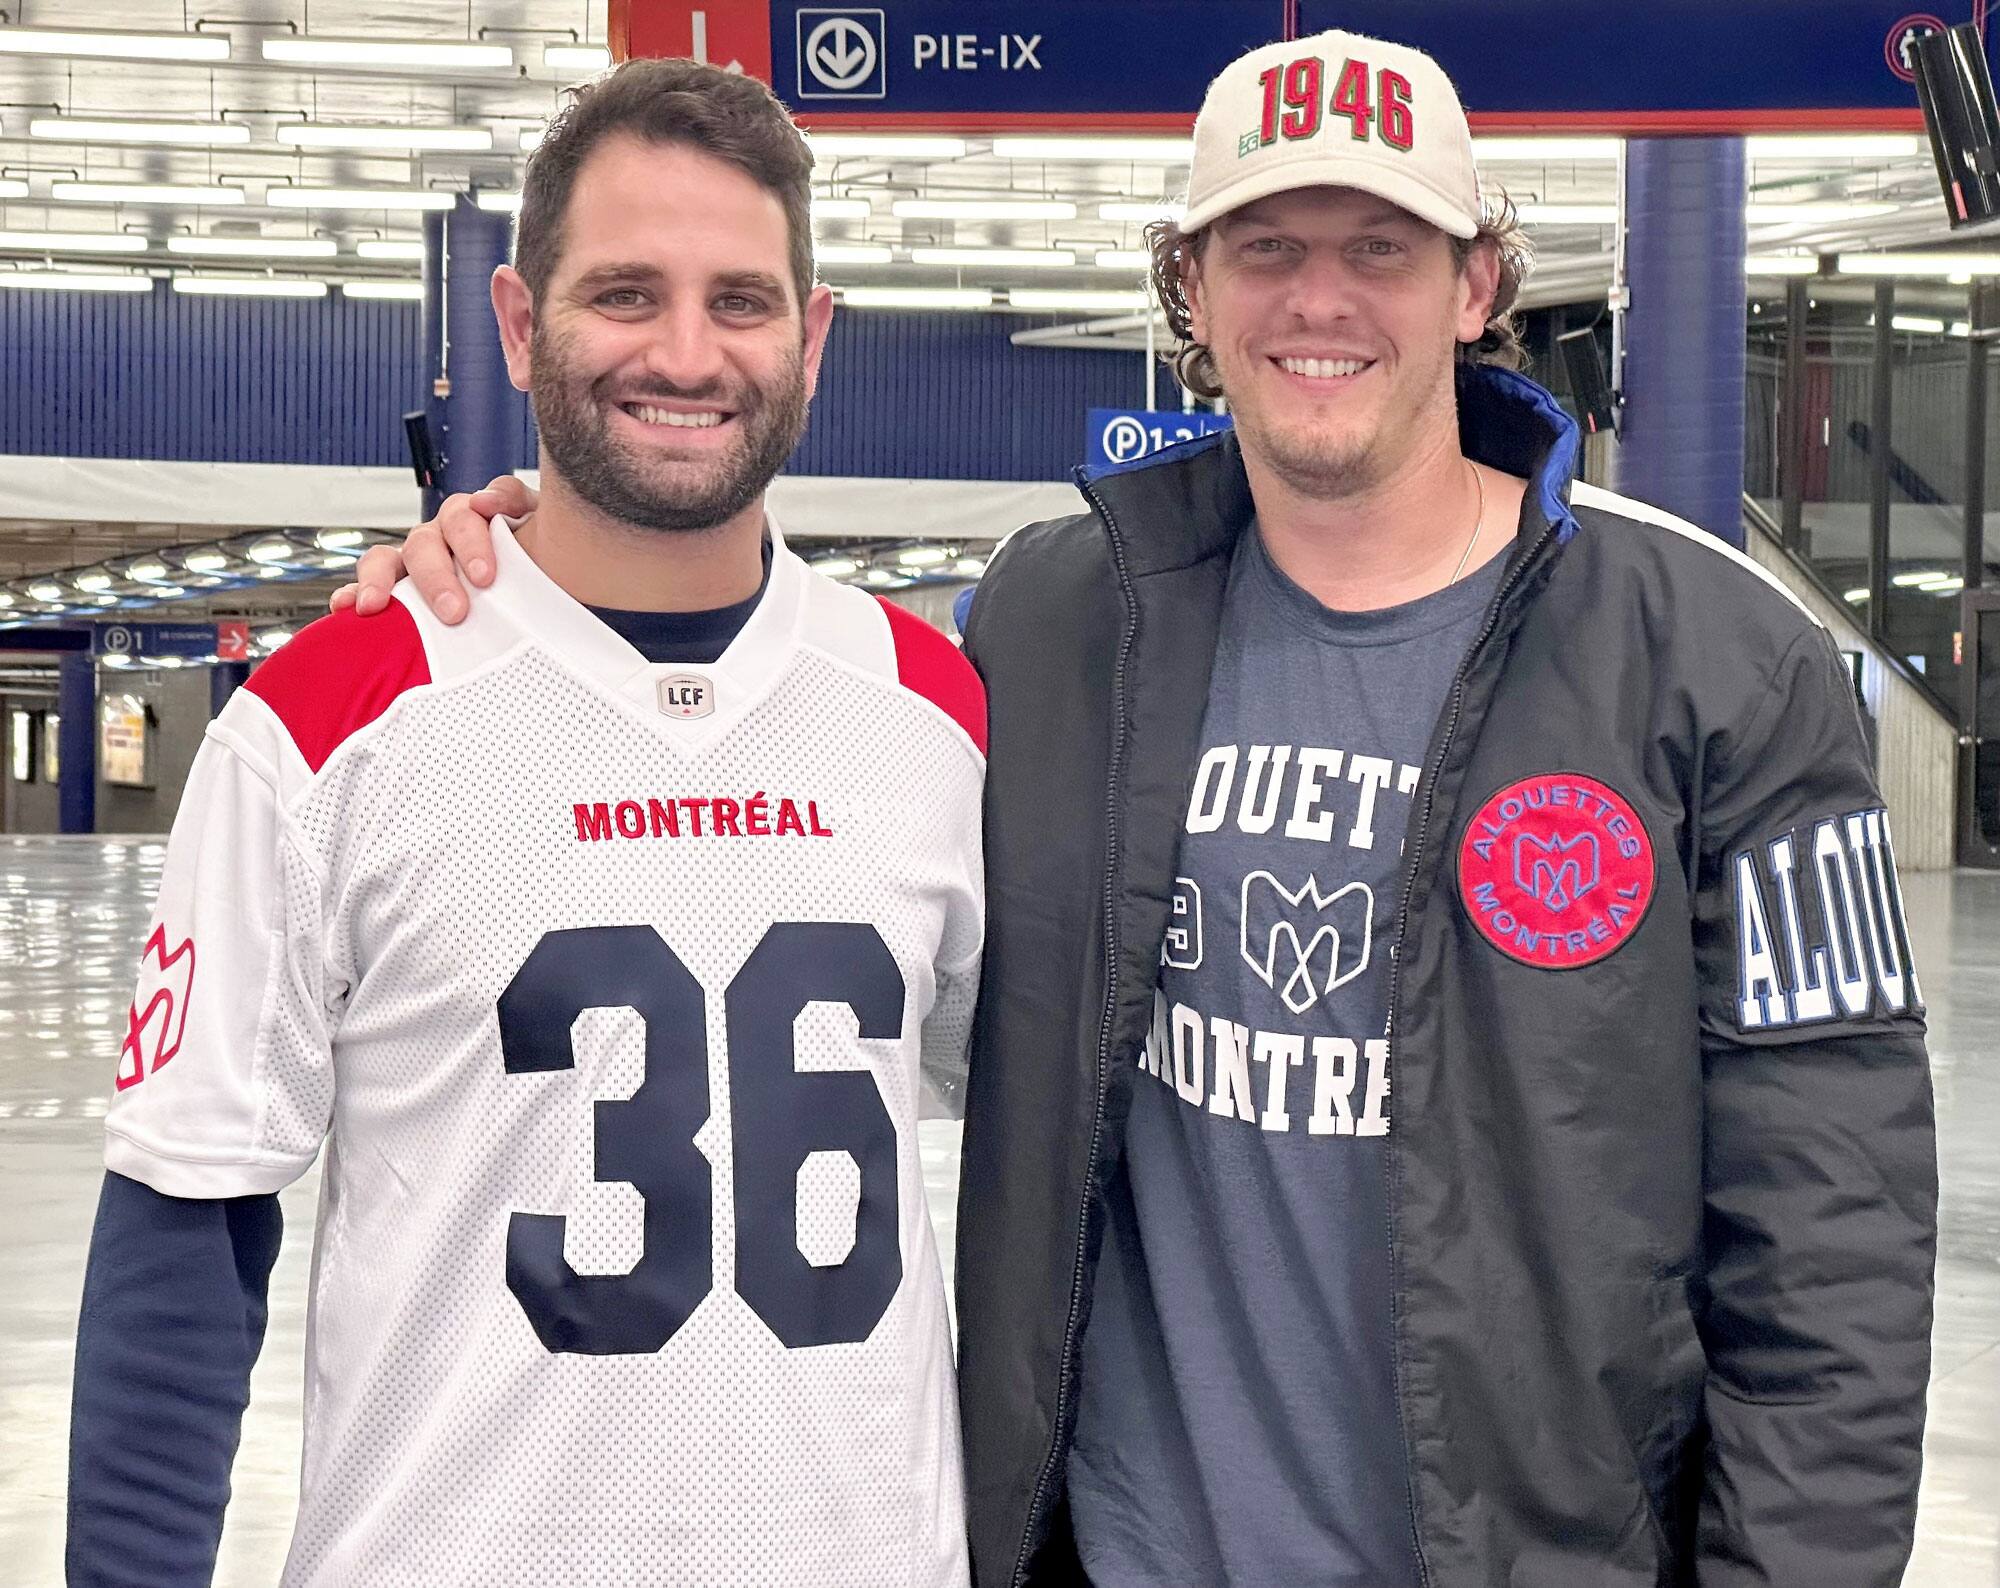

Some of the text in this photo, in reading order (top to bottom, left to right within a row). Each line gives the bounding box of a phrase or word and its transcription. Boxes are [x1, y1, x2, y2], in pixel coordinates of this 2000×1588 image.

[913, 34, 1042, 70] PIE-IX
[1258, 55, 1414, 153] 1946
[668, 687, 703, 705] LCF
[573, 790, 834, 842] MONTRÉAL
[1472, 784, 1641, 862] ALOUETTES
[1472, 881, 1640, 956] MONTRÉAL
[1735, 809, 1925, 1029] ALOU
[497, 922, 906, 1356] 36
